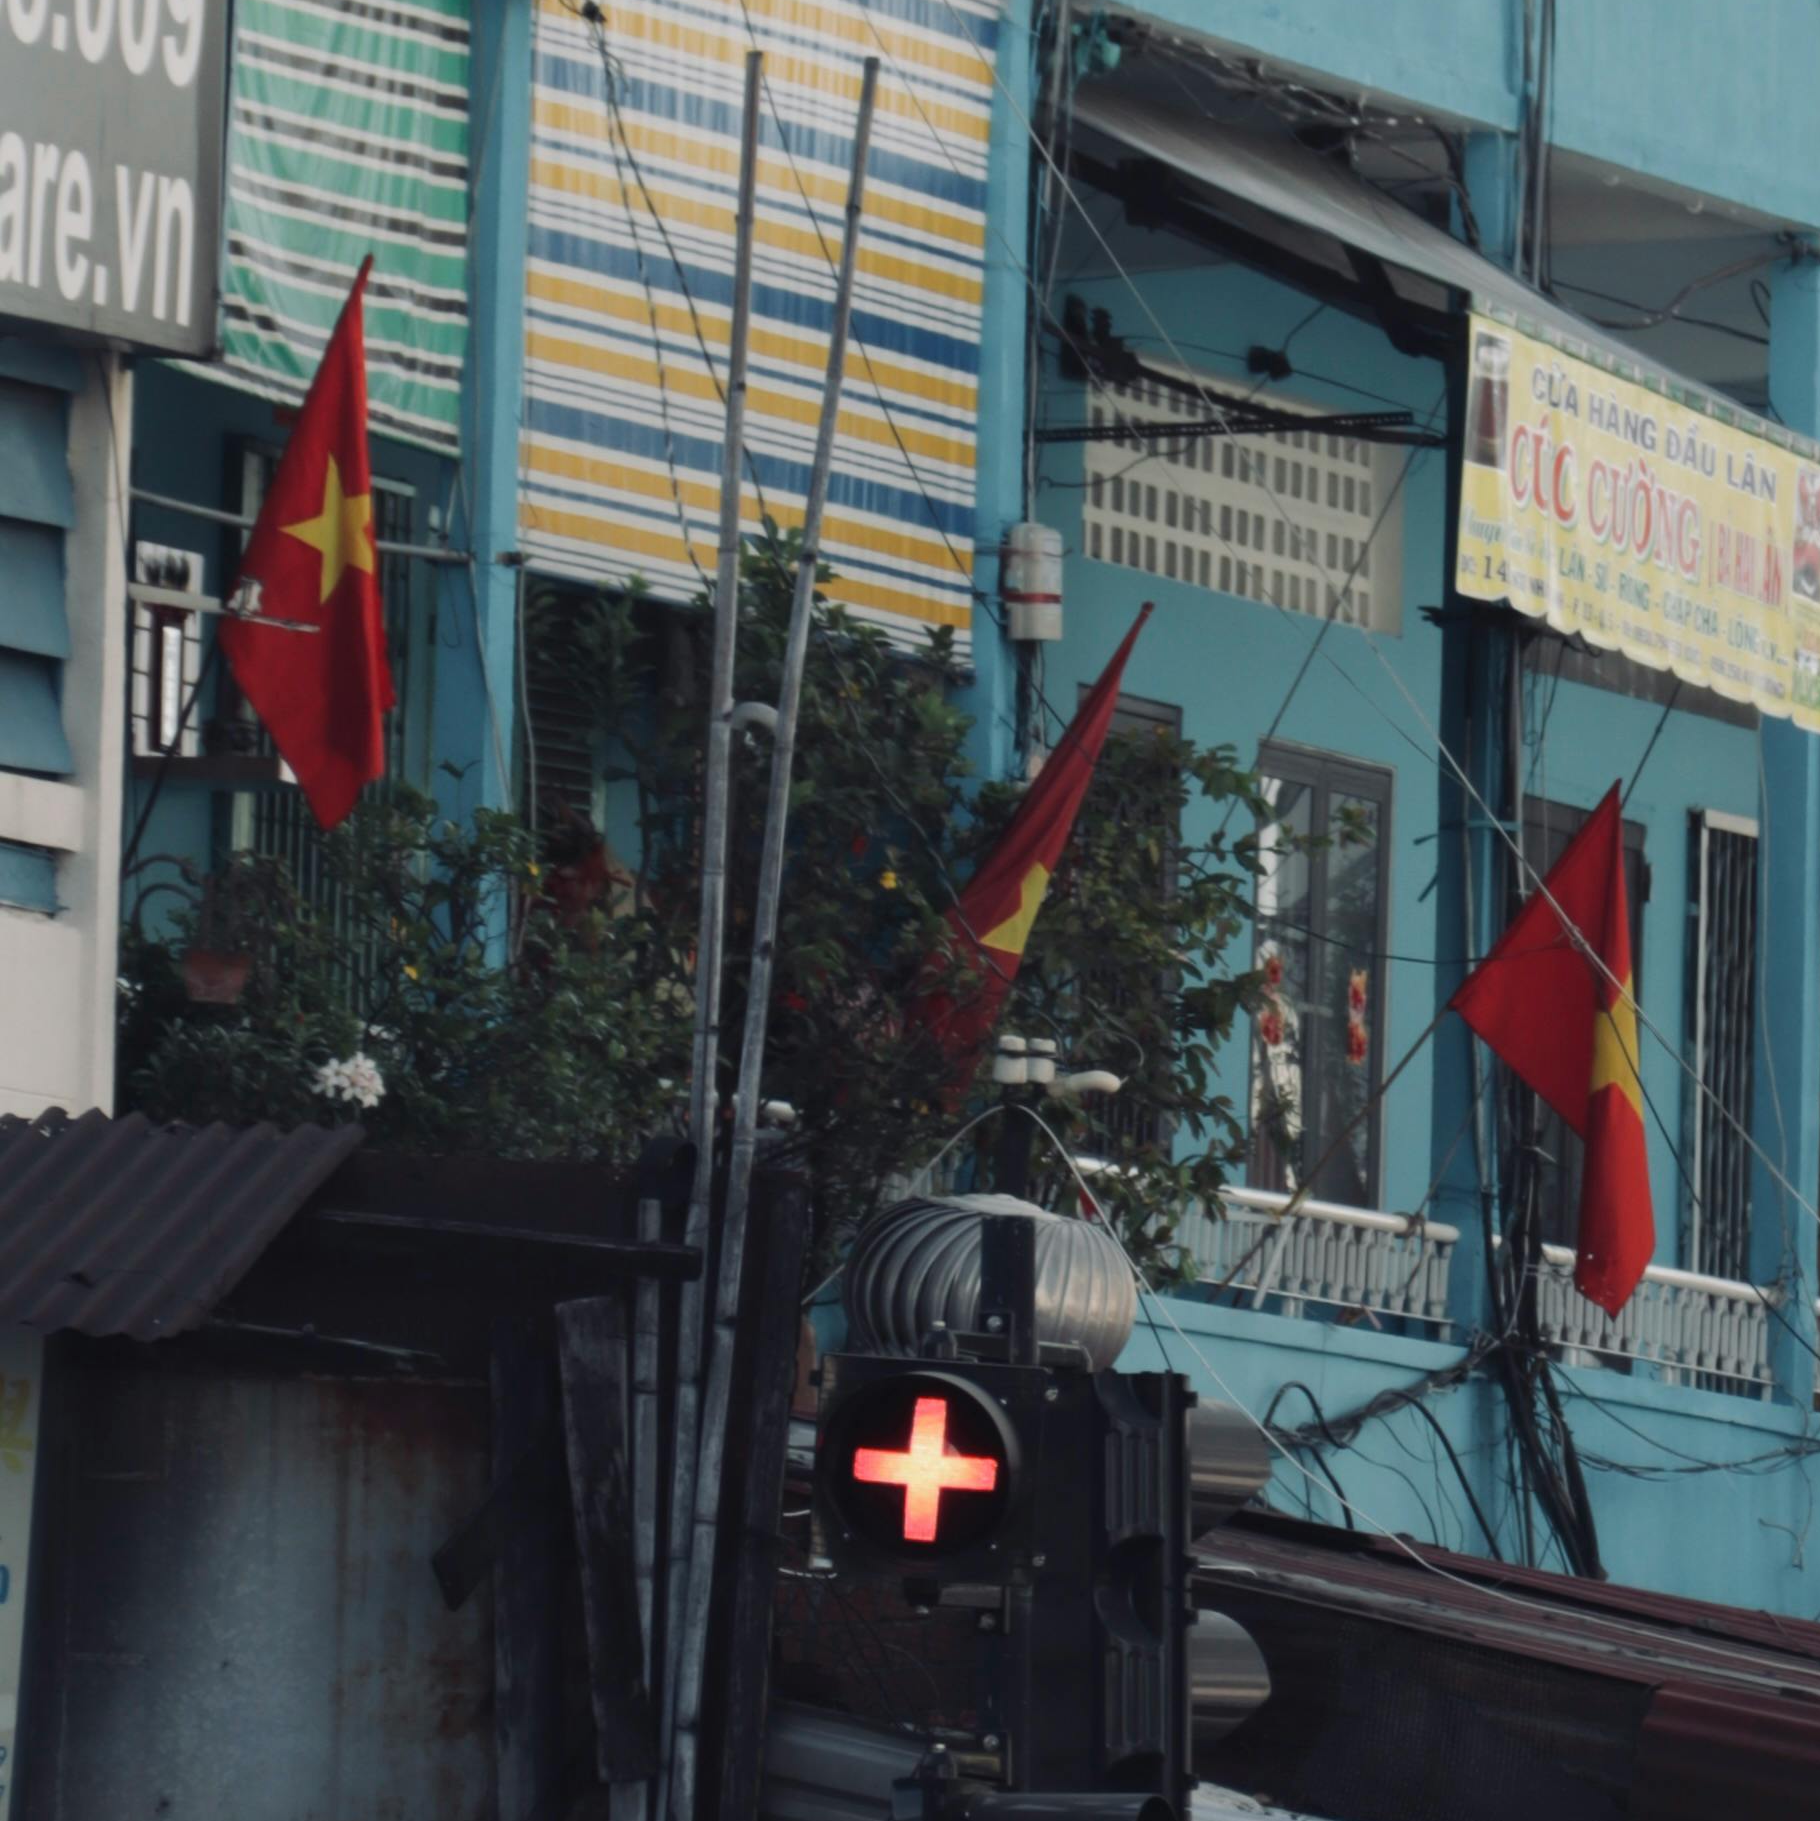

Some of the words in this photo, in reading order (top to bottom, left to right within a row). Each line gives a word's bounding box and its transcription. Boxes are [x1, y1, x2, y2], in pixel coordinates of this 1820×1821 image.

[1589, 390, 1656, 452] HÀNG
[1727, 452, 1776, 502] LÂN
[1588, 457, 1700, 574] CƯỜNG
